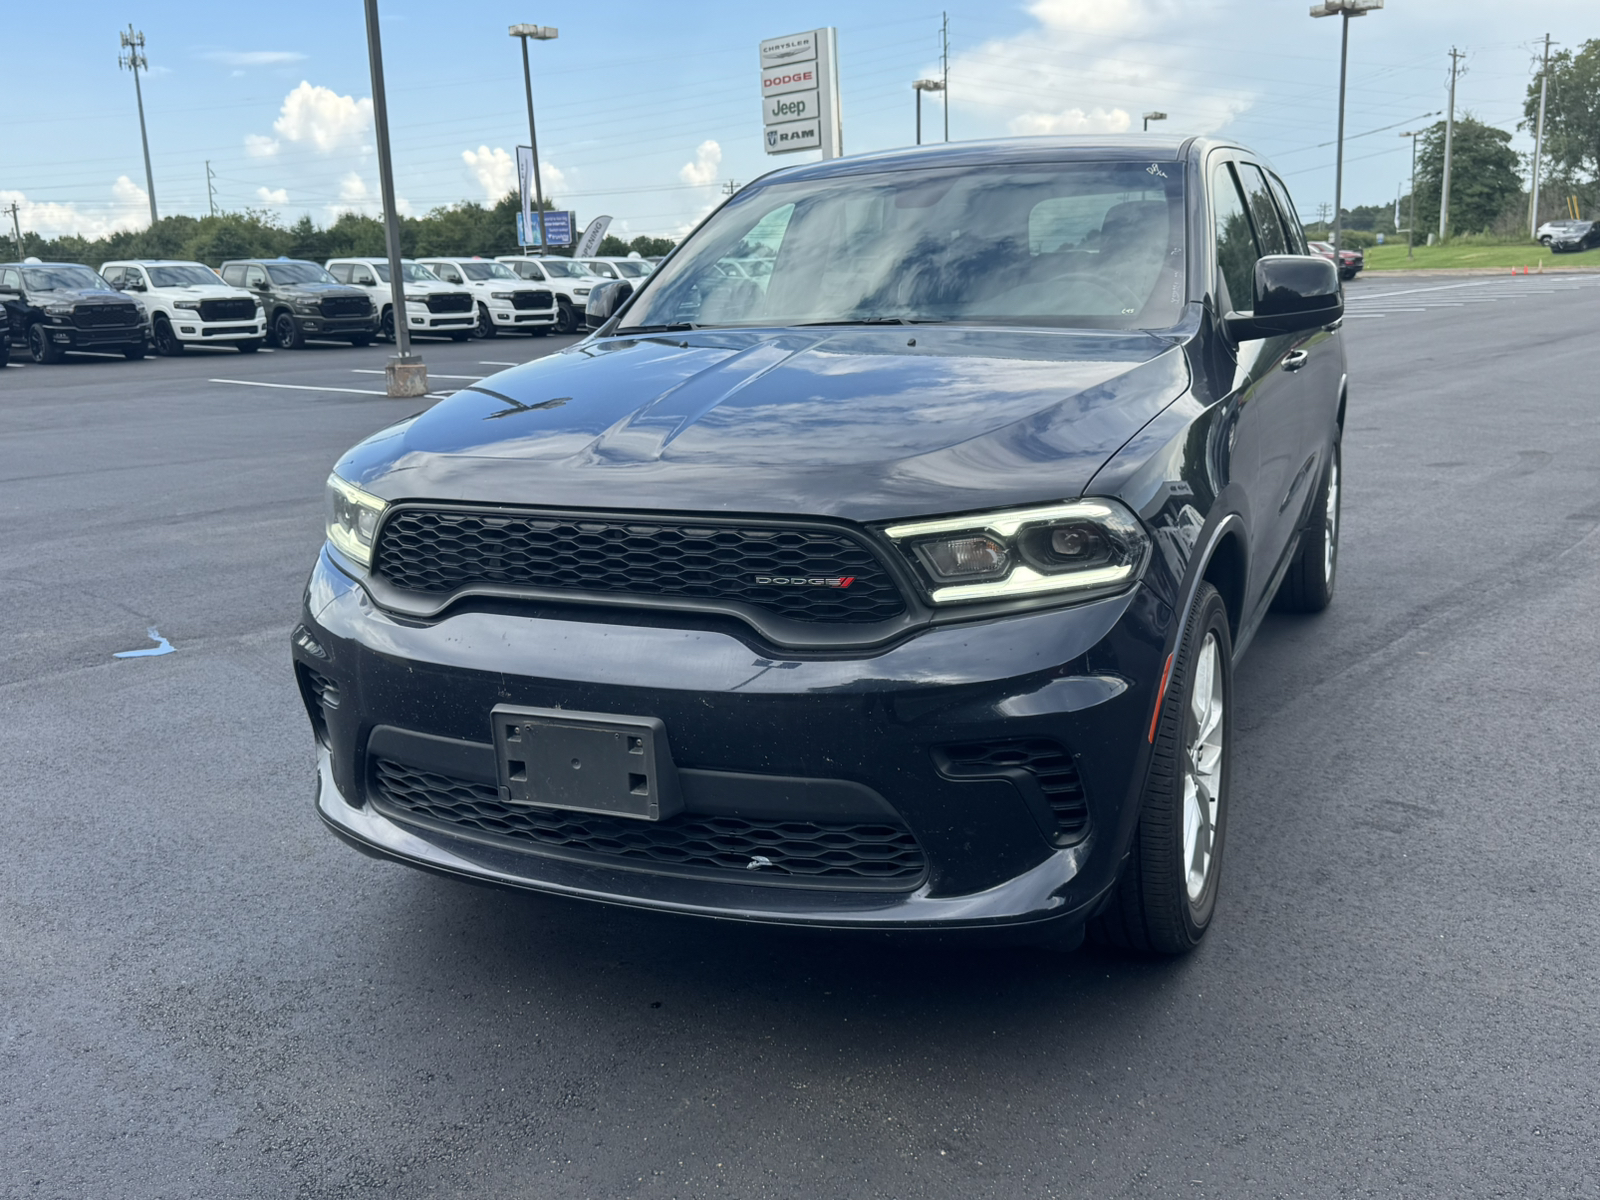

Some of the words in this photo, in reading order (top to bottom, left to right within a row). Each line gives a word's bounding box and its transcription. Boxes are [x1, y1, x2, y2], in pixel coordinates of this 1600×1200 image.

[763, 39, 810, 53] CHRYSLER
[763, 71, 813, 88] DODGE
[772, 99, 806, 117] Jeep
[779, 129, 815, 142] RAM
[755, 577, 842, 586] DODGE
